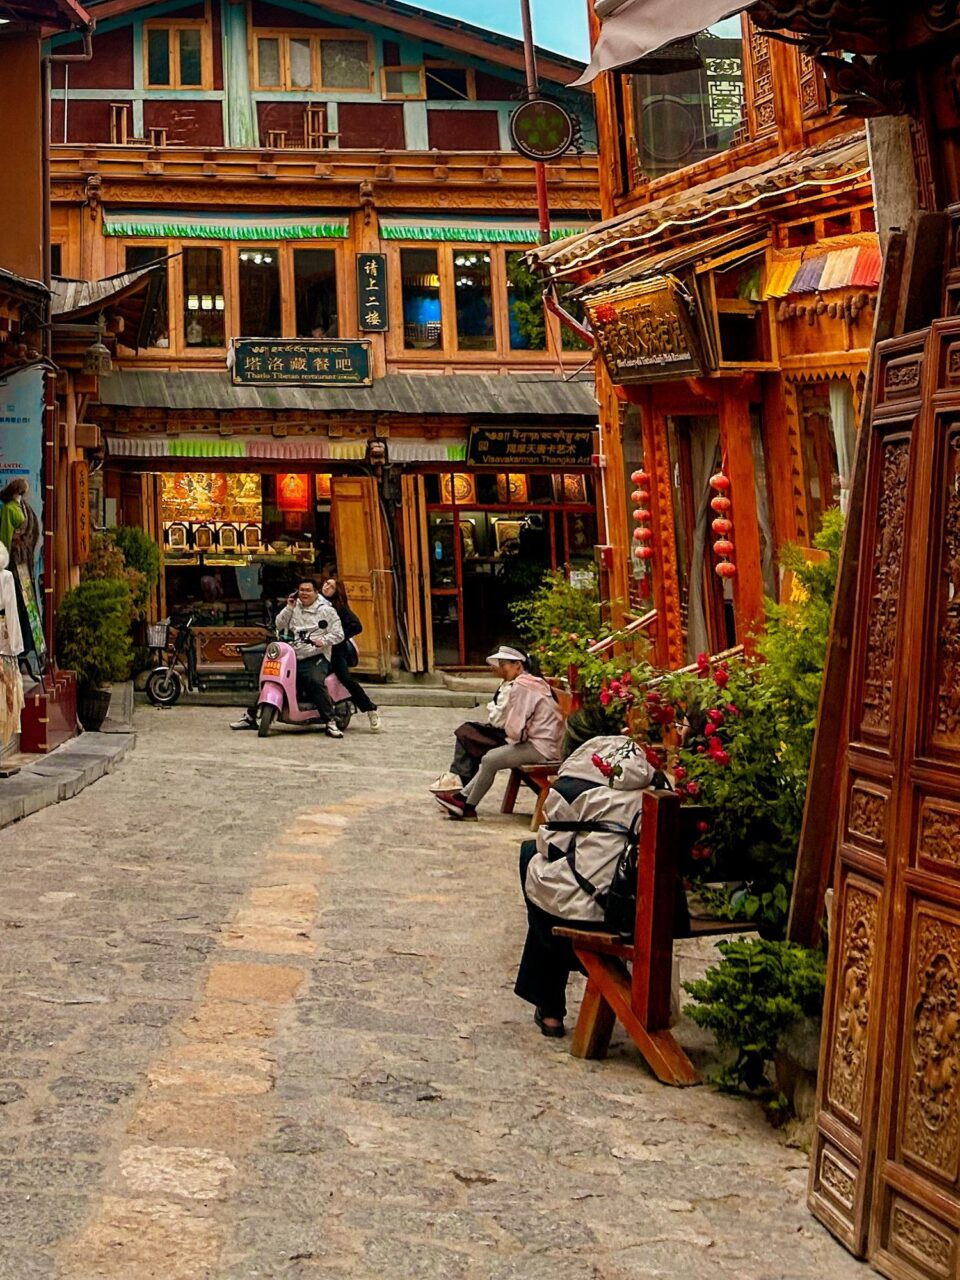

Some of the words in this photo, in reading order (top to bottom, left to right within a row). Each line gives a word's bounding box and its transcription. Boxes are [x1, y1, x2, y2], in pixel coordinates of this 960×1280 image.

[364, 259, 381, 325] 请上二楼
[244, 357, 353, 371] 塔洛藏餐吧
[272, 372, 299, 380] Tibetan
